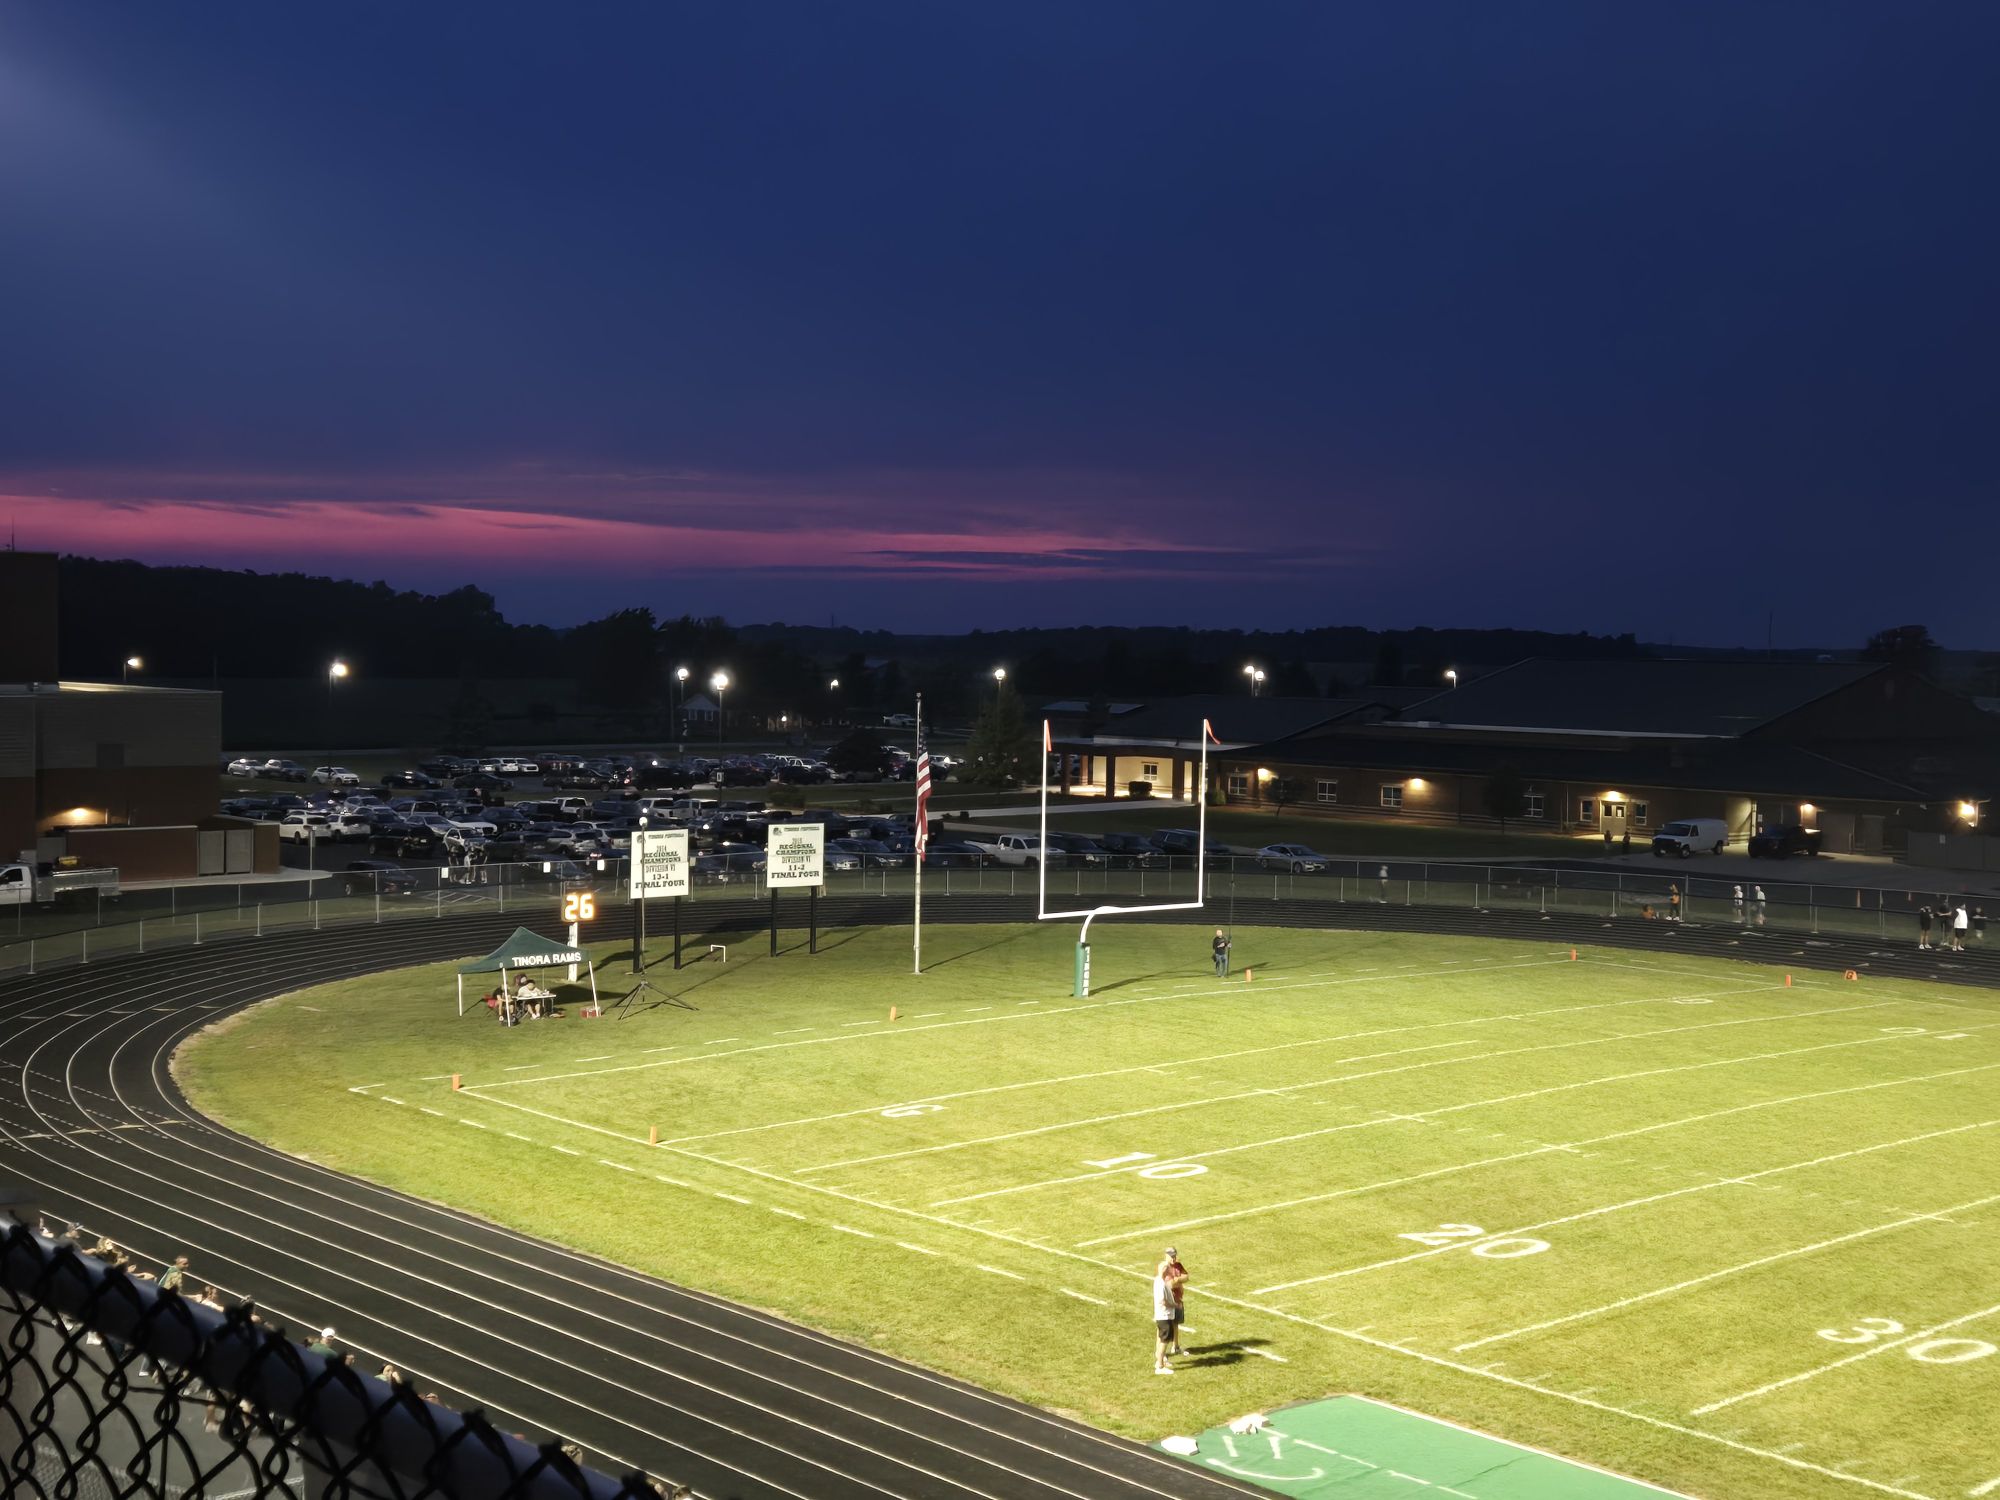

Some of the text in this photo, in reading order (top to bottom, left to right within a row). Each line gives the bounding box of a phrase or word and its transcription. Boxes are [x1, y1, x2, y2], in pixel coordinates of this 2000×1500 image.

[640, 856, 681, 864] CHAMPIONS
[798, 870, 820, 878] FOUR
[662, 879, 685, 887] FOUR
[565, 893, 594, 920] 26
[511, 952, 582, 967] TINORA RAMS
